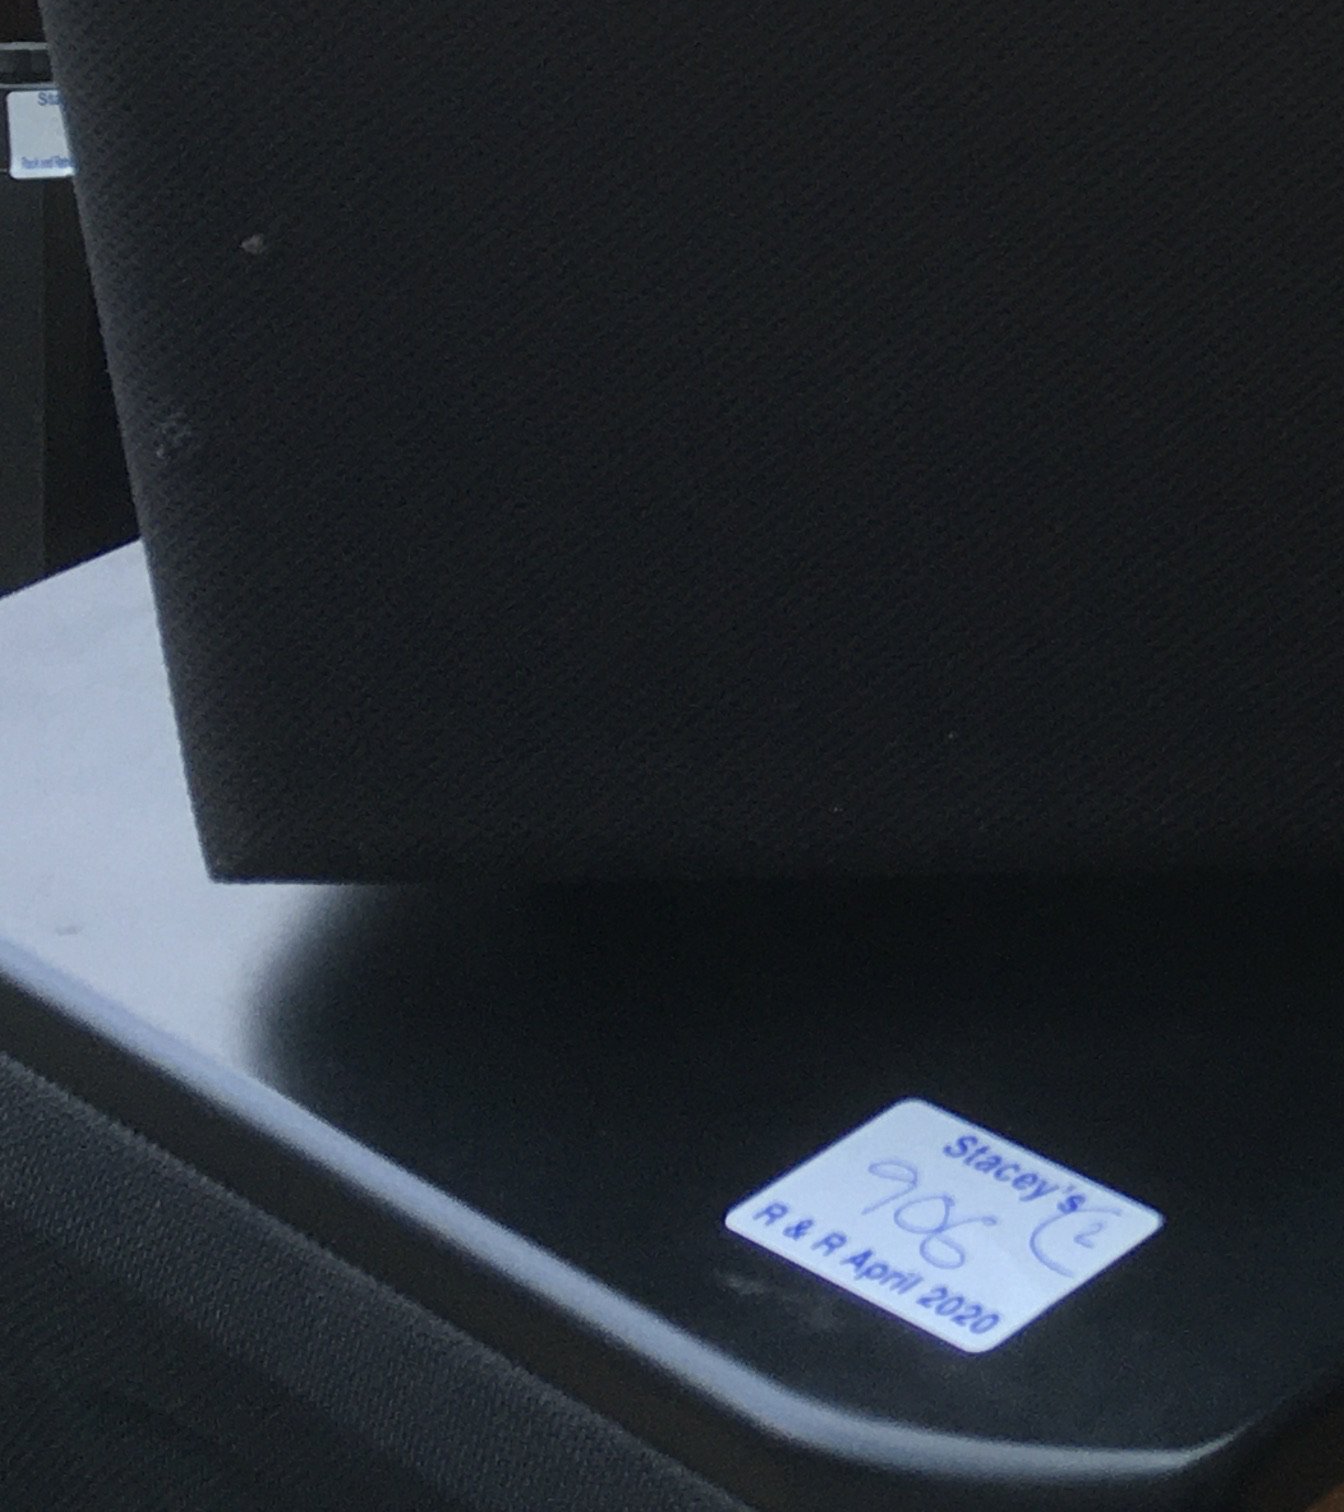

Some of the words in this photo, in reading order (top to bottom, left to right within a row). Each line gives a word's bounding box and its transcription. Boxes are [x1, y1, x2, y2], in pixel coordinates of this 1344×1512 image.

[861, 1159, 998, 1270] 906
[942, 1134, 1087, 1215] Stacey's
[752, 1200, 789, 1228] R
[782, 1218, 815, 1242] &
[810, 1230, 849, 1257] R
[840, 1248, 924, 1296] April
[916, 1286, 1001, 1336] 2020
